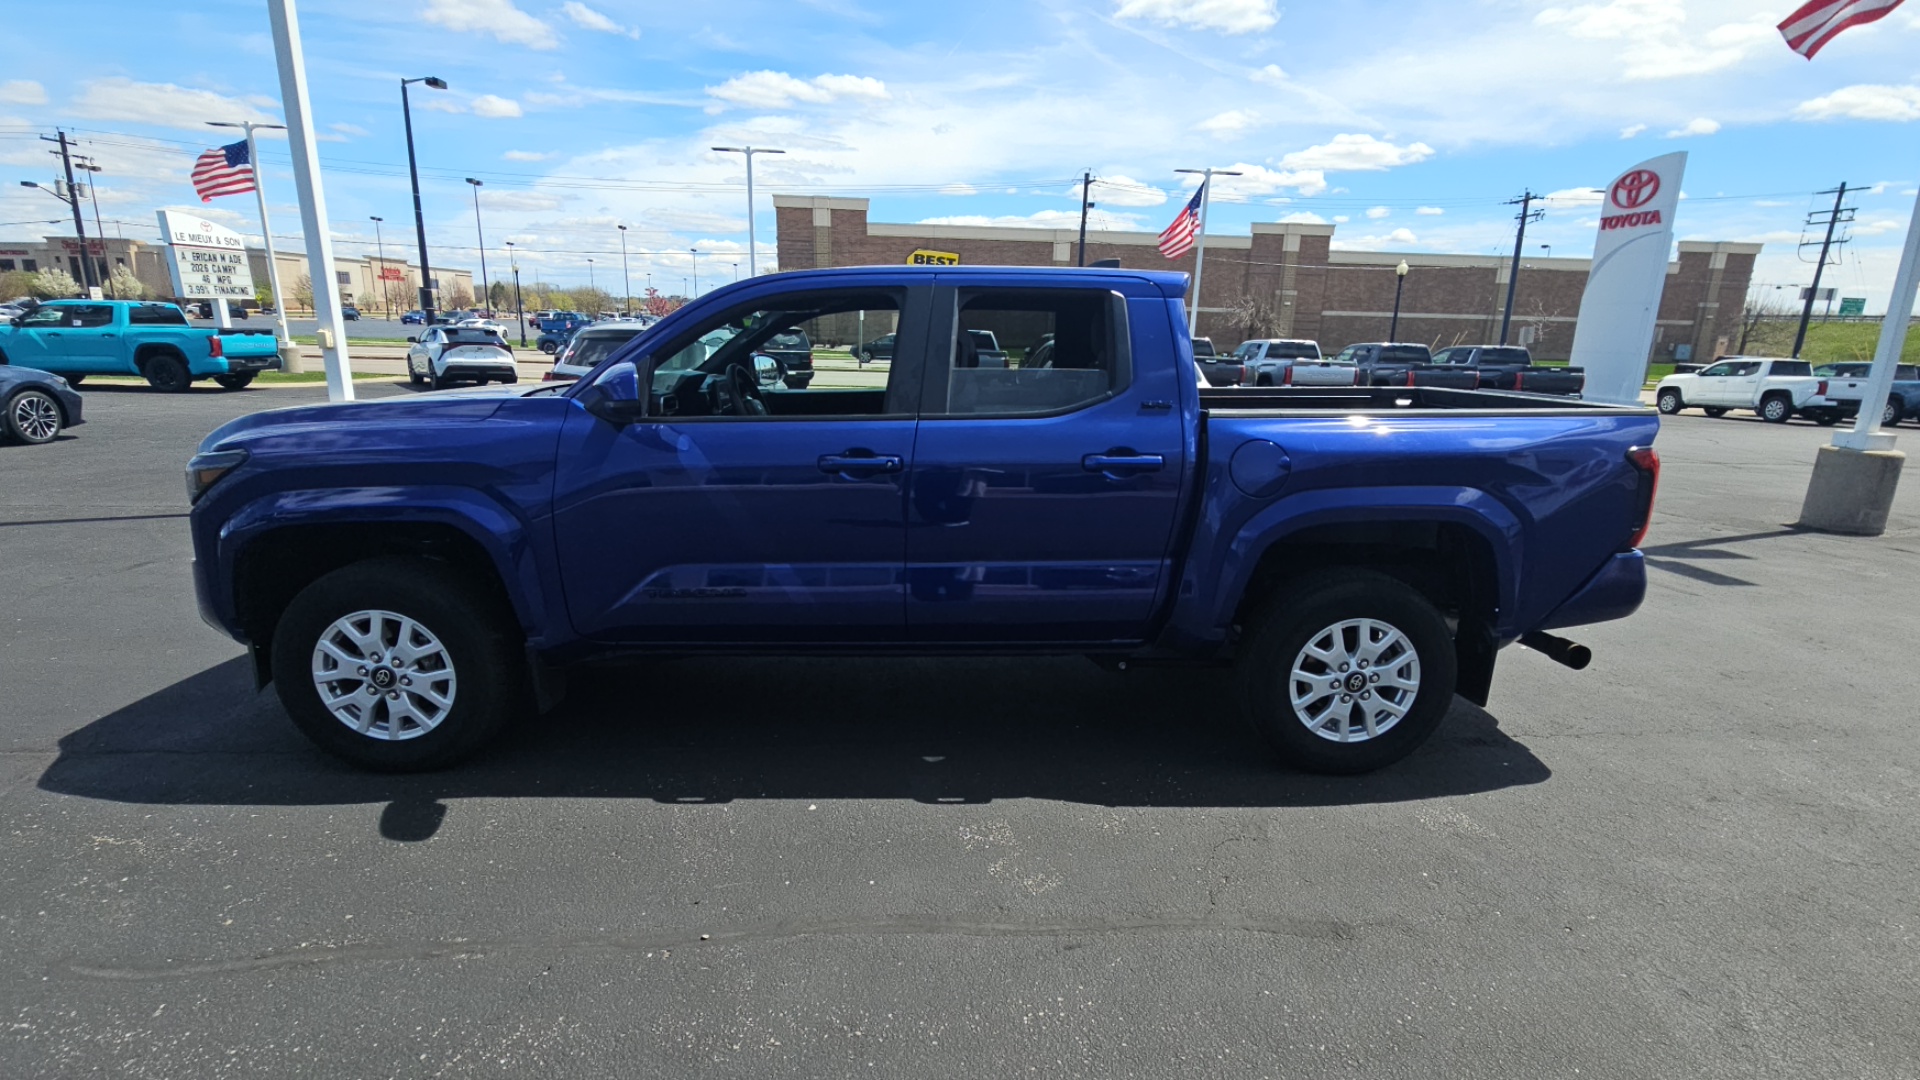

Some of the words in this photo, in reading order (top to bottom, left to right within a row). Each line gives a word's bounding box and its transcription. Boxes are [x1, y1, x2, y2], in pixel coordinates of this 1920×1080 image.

[1600, 209, 1662, 231] TOYOTA
[175, 232, 186, 242] LE
[188, 233, 213, 244] MIEUX
[215, 236, 222, 245] &
[224, 237, 241, 247] SON
[913, 253, 957, 266] BEST
[191, 263, 209, 273] 2026
[212, 264, 237, 274] CAMRY
[202, 274, 211, 284] 46
[216, 275, 232, 285] MPG
[188, 285, 210, 295] 3.99%
[214, 286, 249, 296] FINANCING
